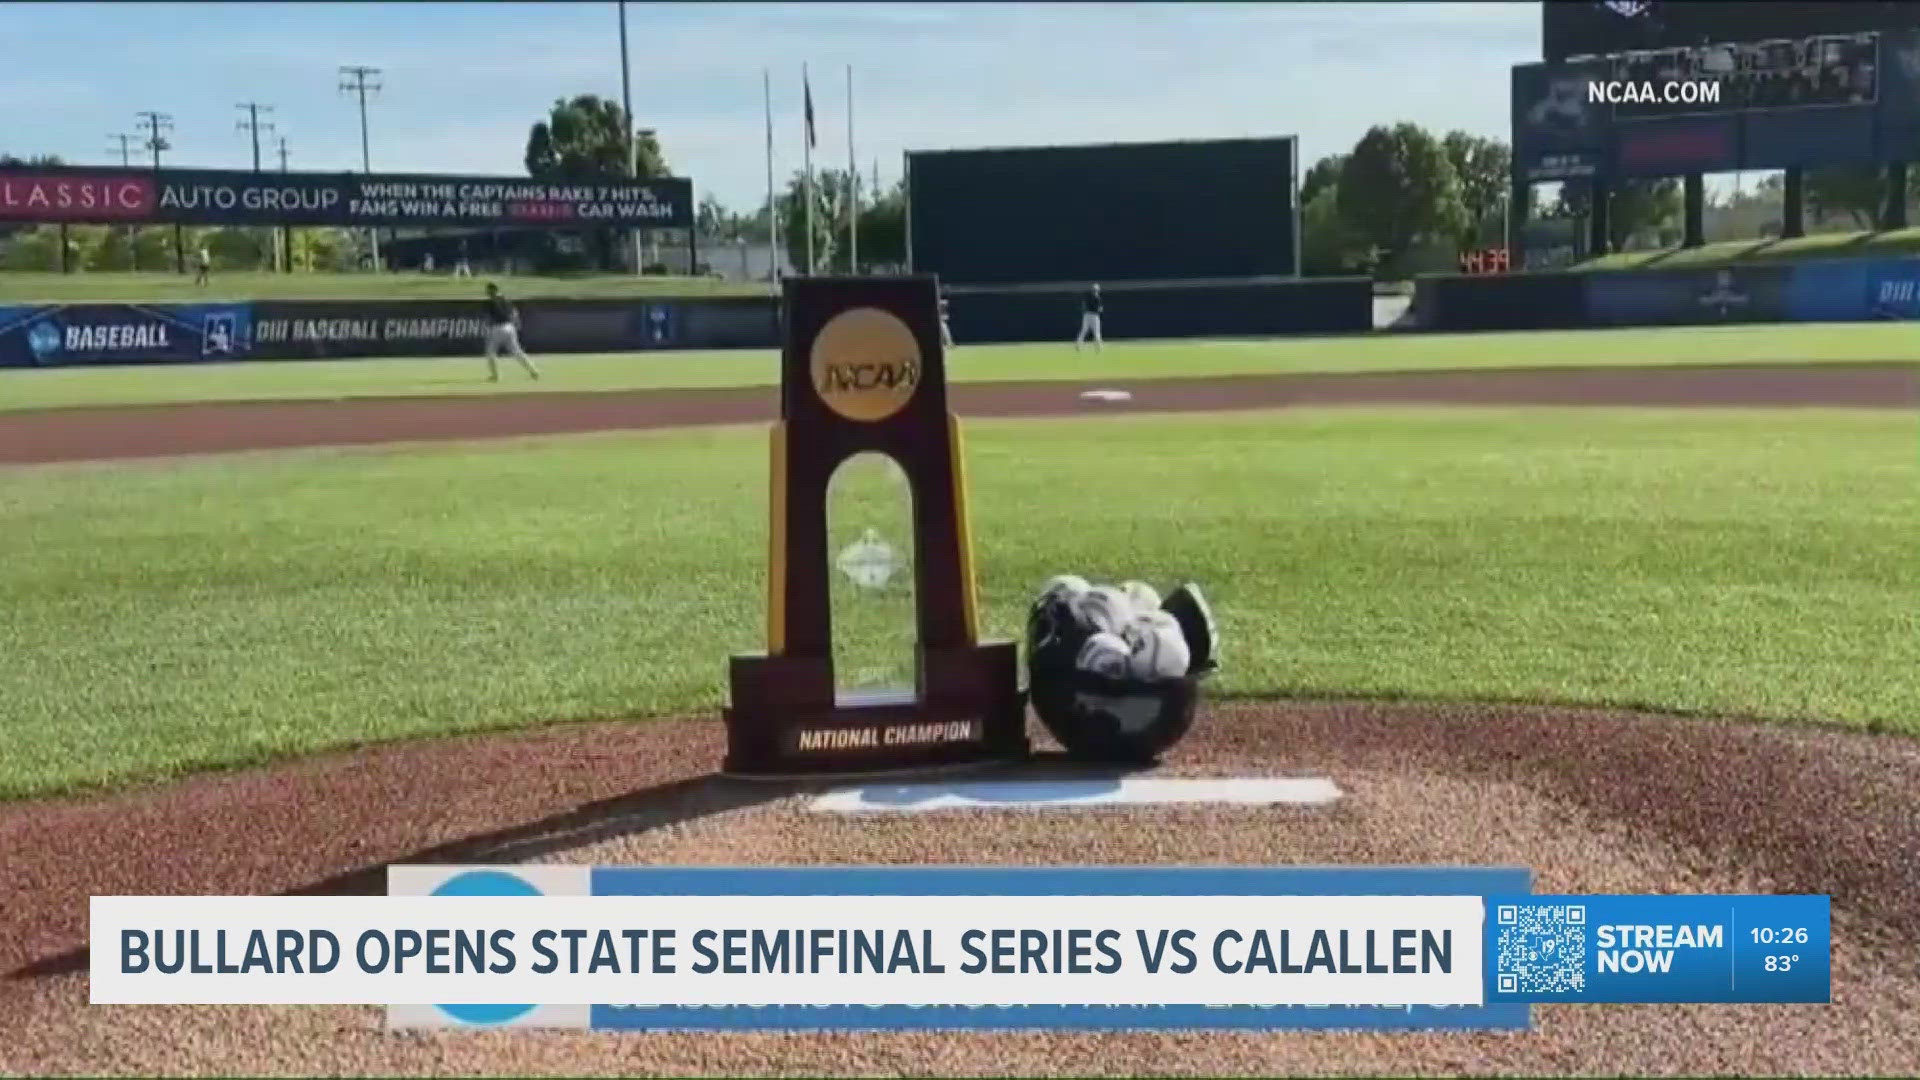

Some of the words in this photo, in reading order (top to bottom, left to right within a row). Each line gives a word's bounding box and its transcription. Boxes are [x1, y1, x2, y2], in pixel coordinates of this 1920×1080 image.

[160, 186, 237, 210] AUTO
[242, 187, 339, 210] GROUP
[360, 183, 417, 198] WHEN
[421, 184, 456, 199] THE
[459, 184, 546, 201] CAPTAINS
[350, 200, 399, 216] FANS
[401, 201, 438, 216] WIN
[442, 201, 457, 216] A
[459, 201, 503, 217] FREE
[578, 202, 614, 217] CAR
[616, 203, 673, 218] WASH
[66, 323, 169, 350] BASEBALL
[292, 319, 379, 341] BASEBALL
[823, 361, 915, 391] NCAA
[799, 727, 879, 750] NATIONAL
[884, 719, 971, 744] CHAMPION
